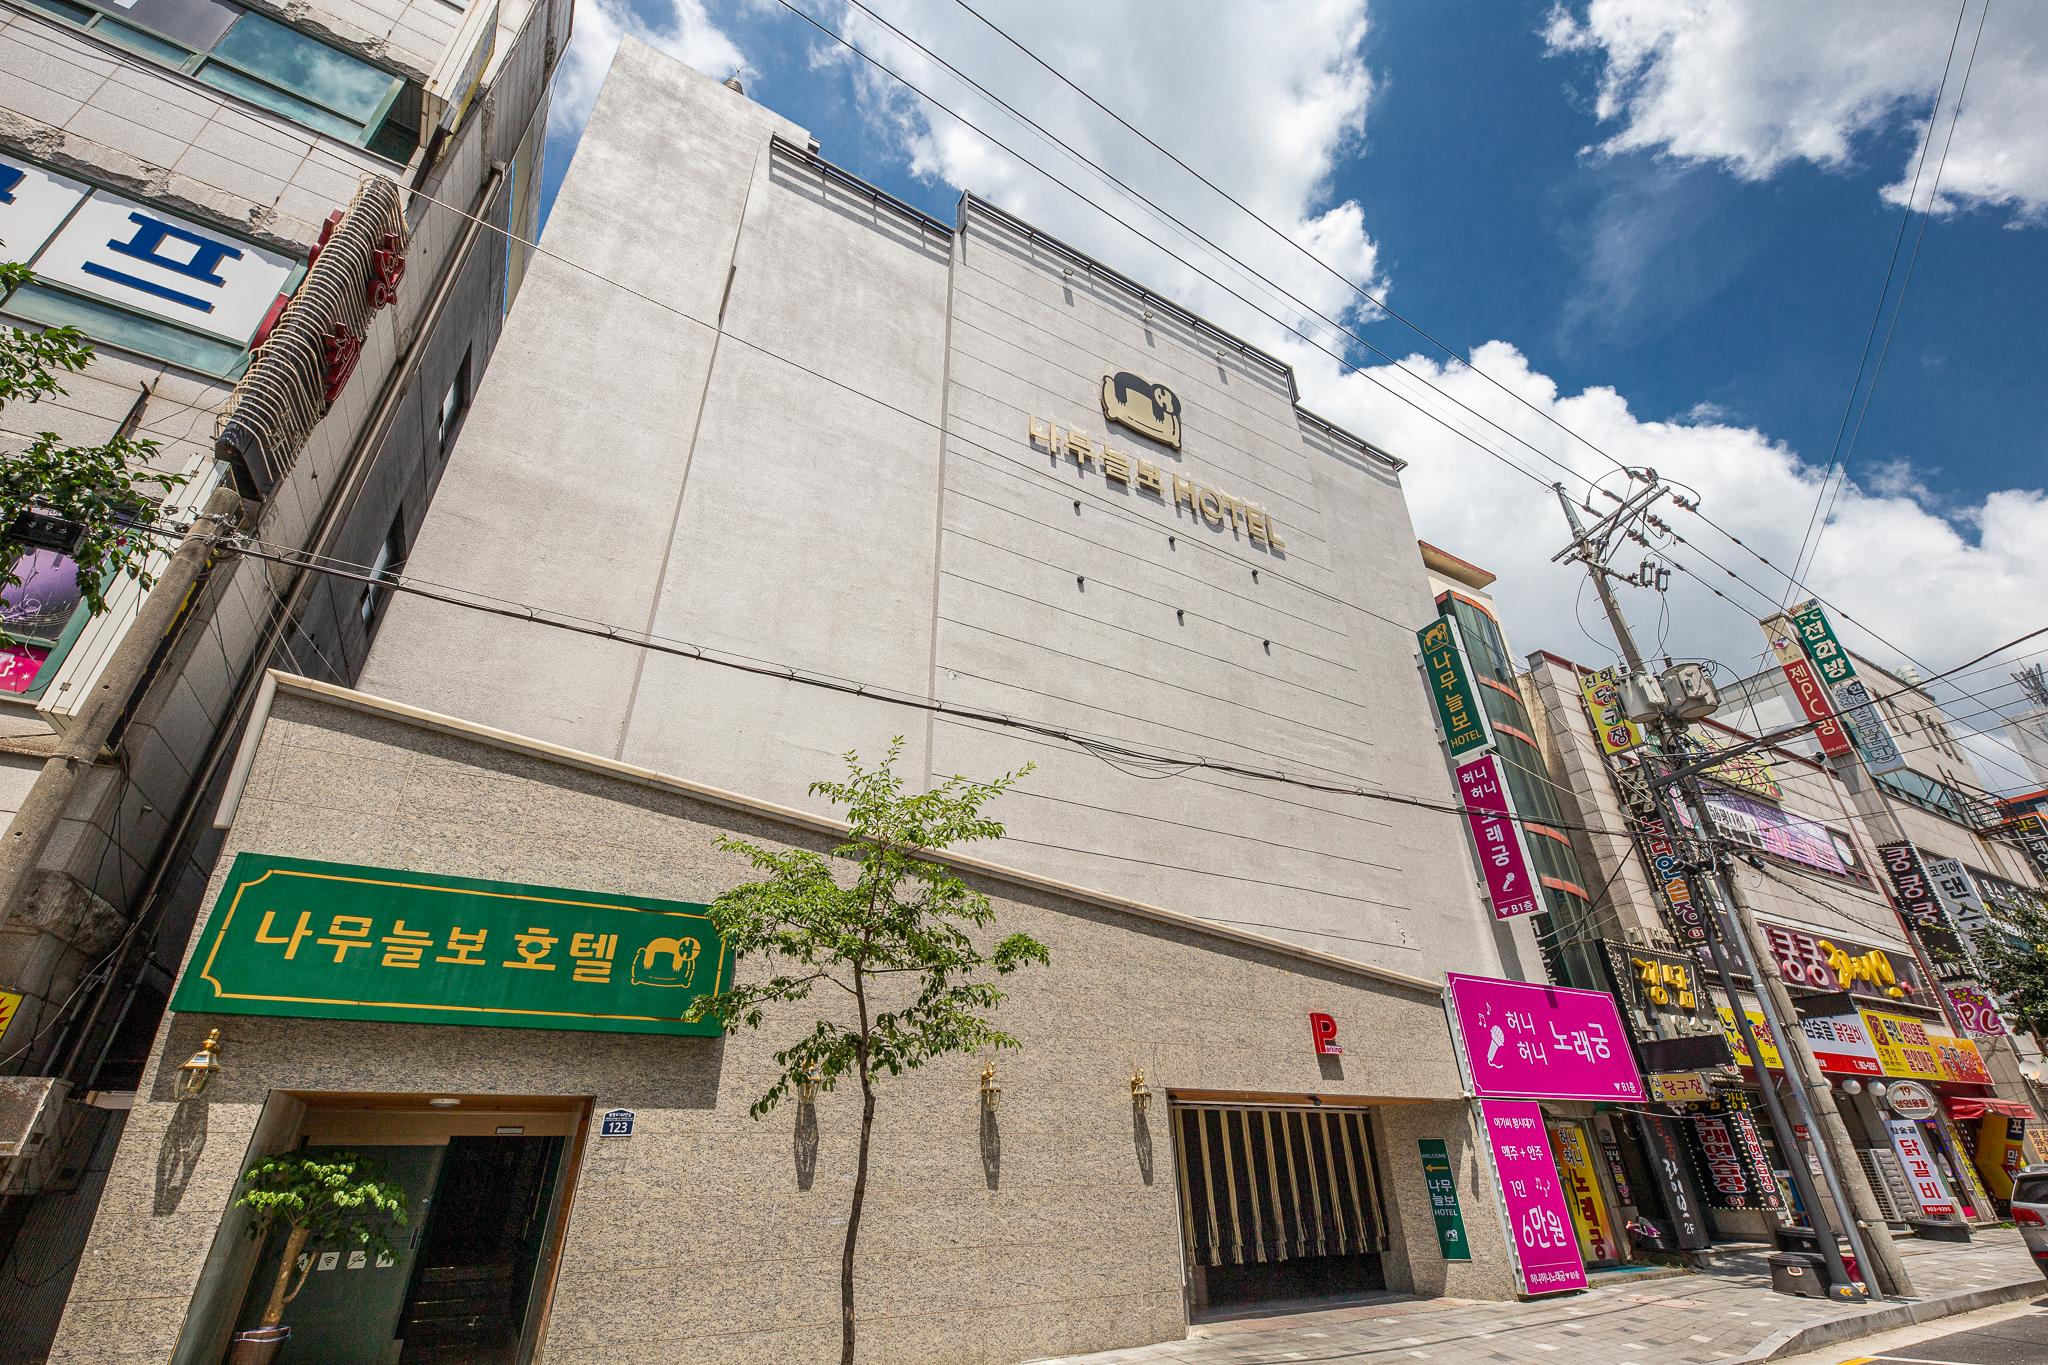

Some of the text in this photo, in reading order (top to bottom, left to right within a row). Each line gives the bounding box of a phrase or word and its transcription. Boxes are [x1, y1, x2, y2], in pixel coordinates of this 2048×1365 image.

[1029, 415, 1286, 549] 나무늘보 HOTEL
[1802, 620, 1847, 679] 전화방
[1433, 651, 1471, 732] 나무늘보
[1450, 729, 1482, 748] HOTEL
[1462, 766, 1487, 784] 허니
[1471, 781, 1497, 798] 허니
[1929, 861, 1961, 877] 코리아
[1511, 900, 1533, 914] B1층
[254, 909, 617, 984] 나무늘보 호텔
[1759, 927, 1830, 986] 쿵쿵
[1505, 1011, 1536, 1036] 허니
[1831, 1021, 1866, 1045] 닭갈비
[1517, 1041, 1549, 1066] 허니
[1549, 1020, 1611, 1065] 노래궁
[1662, 1080, 1703, 1098] 당구장
[1900, 1086, 1911, 1096] 19
[609, 1122, 628, 1133] 123
[1501, 1145, 1519, 1161] 맥주
[1526, 1145, 1544, 1161] 안주
[1737, 1111, 1775, 1193] 노래연습장
[1898, 1139, 1942, 1200] 닭갈비
[1429, 1179, 1452, 1192] 나무
[1510, 1179, 1527, 1198] 1인
[1431, 1194, 1457, 1206] 늘보
[1434, 1208, 1459, 1216] HOTEL
[1522, 1204, 1567, 1249] 6만원
[1685, 1222, 1695, 1235] 2F
